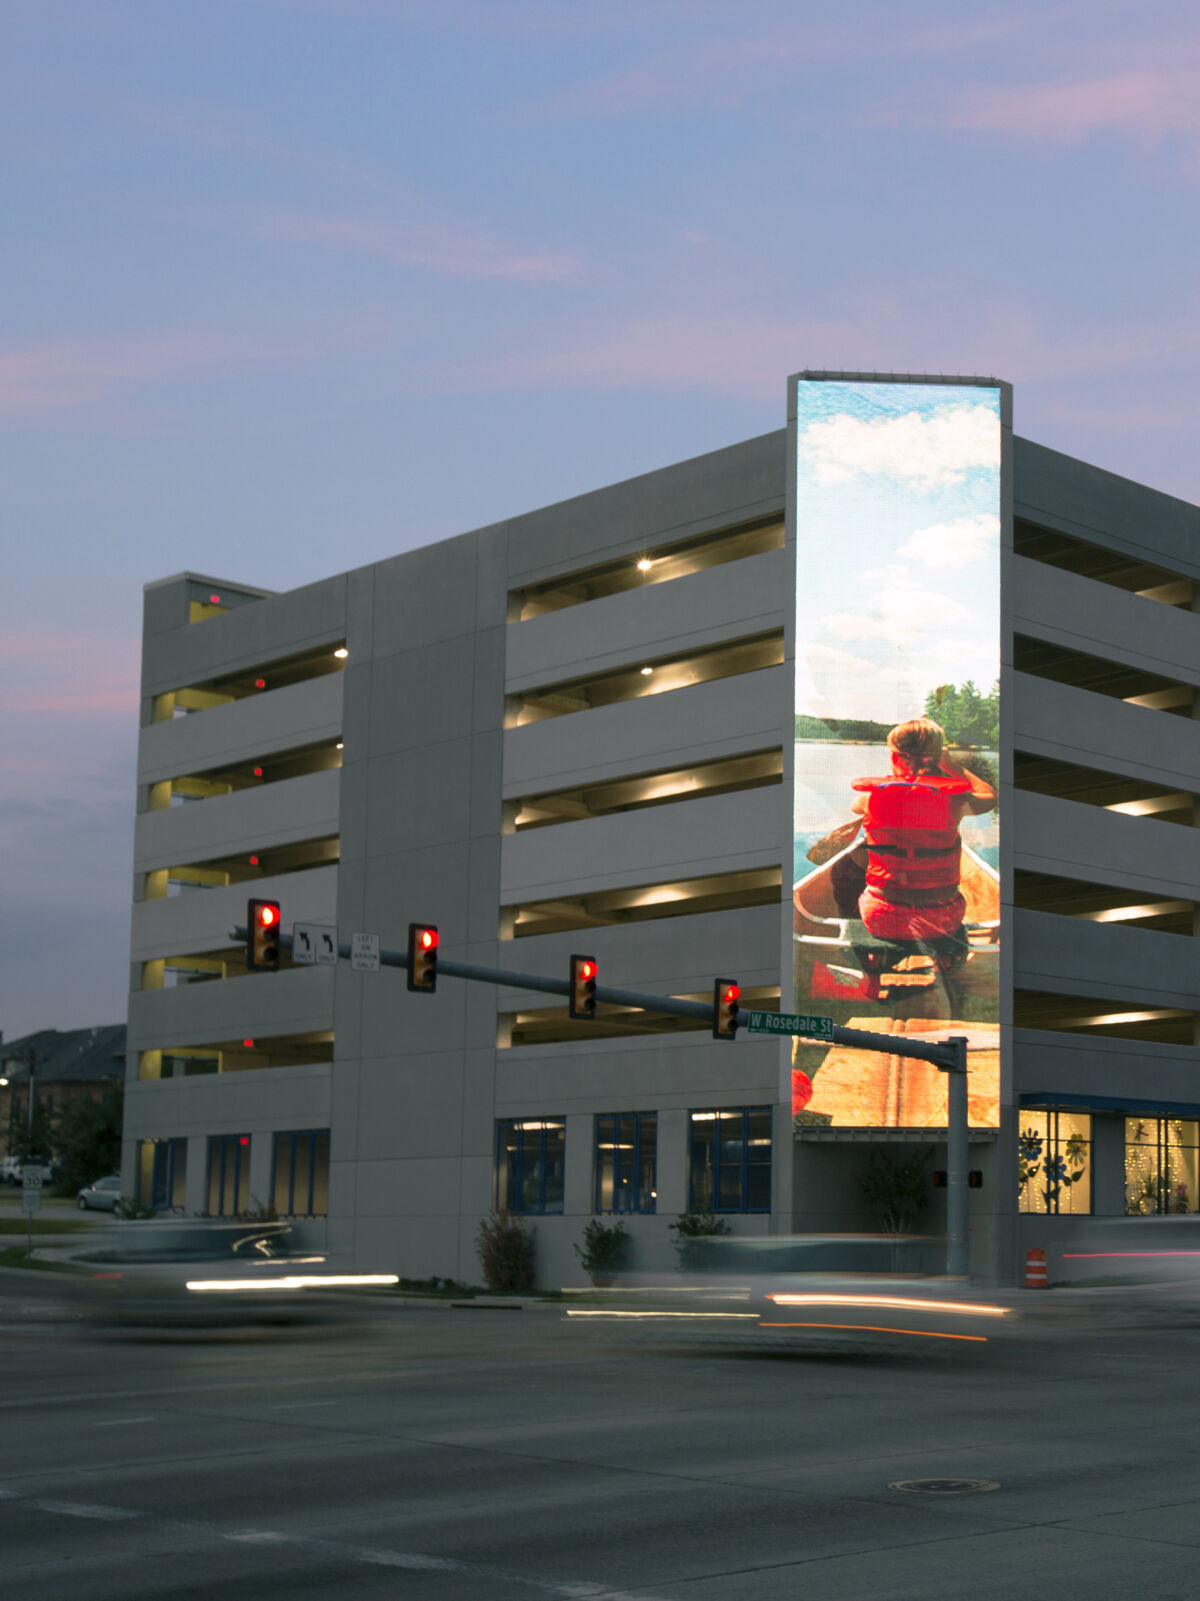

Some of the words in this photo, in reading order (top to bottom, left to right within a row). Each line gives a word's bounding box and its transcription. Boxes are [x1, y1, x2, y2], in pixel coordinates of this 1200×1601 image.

[751, 1013, 762, 1027] W
[765, 1014, 817, 1031] Rosedale
[820, 1018, 832, 1032] St
